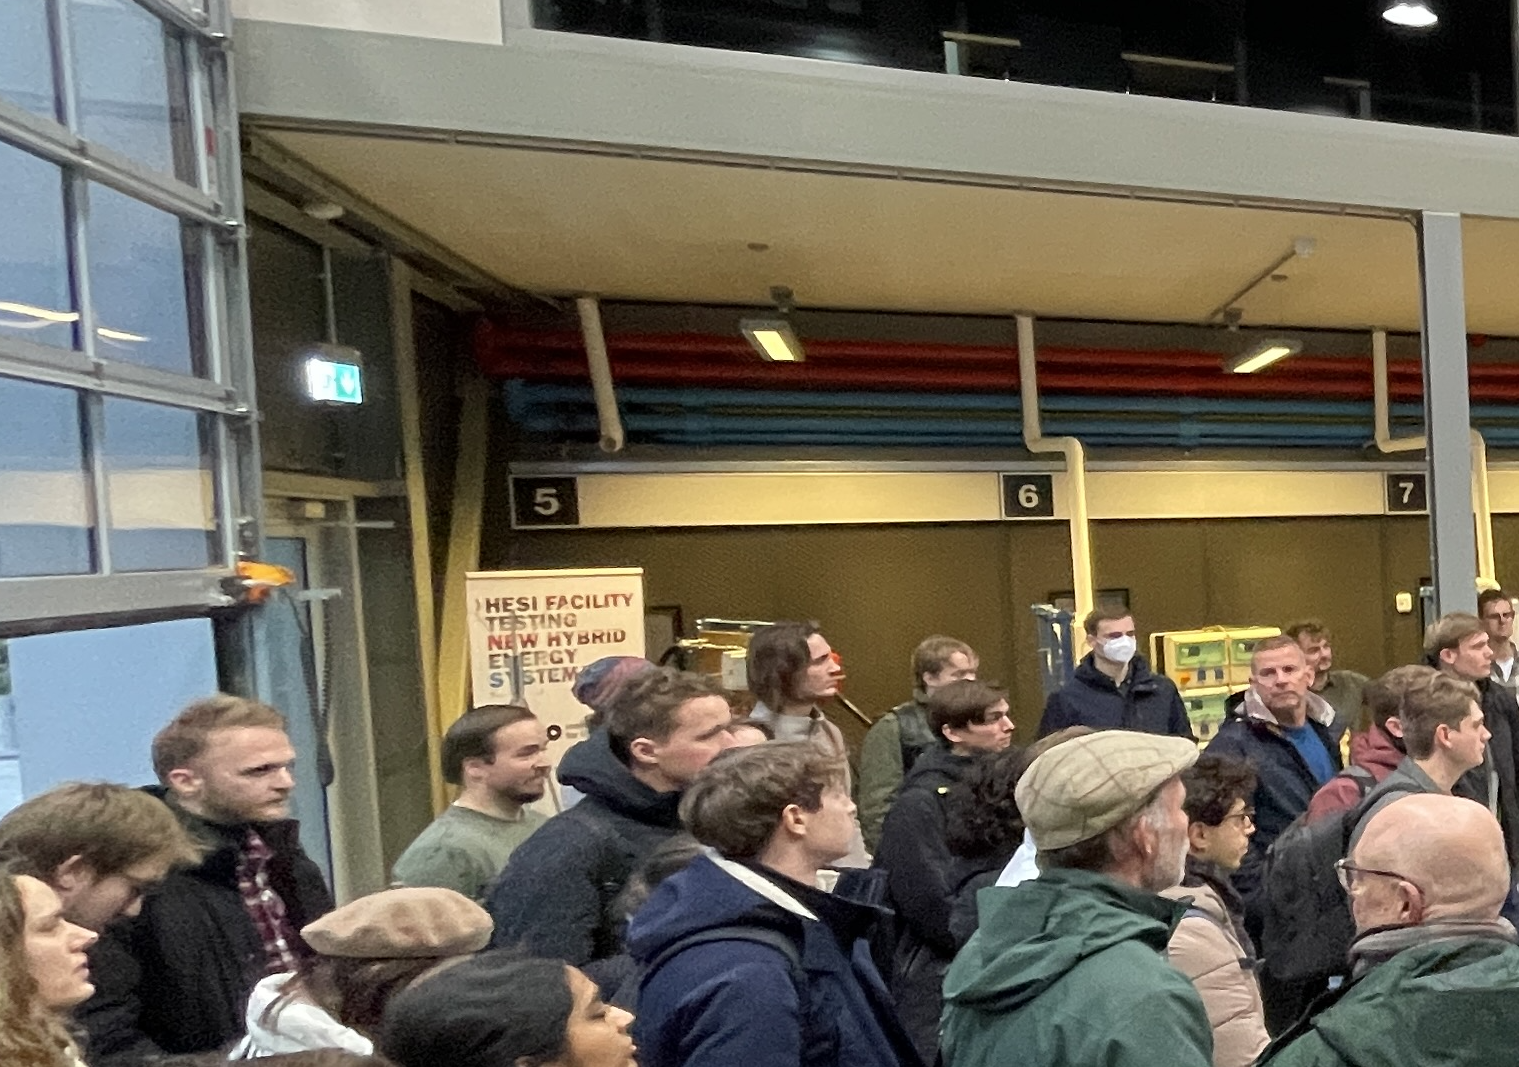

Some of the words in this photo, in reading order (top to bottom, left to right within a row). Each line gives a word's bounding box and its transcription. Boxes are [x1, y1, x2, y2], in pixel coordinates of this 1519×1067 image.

[533, 488, 560, 516] 5
[1018, 483, 1040, 508] 6
[1398, 482, 1414, 504] 7
[485, 596, 538, 614] HESI
[545, 593, 634, 611] FACILITY
[485, 612, 578, 632] TESTING
[487, 633, 538, 651] NEW
[547, 629, 627, 648] HYBRID
[489, 666, 579, 689] SSTEM
